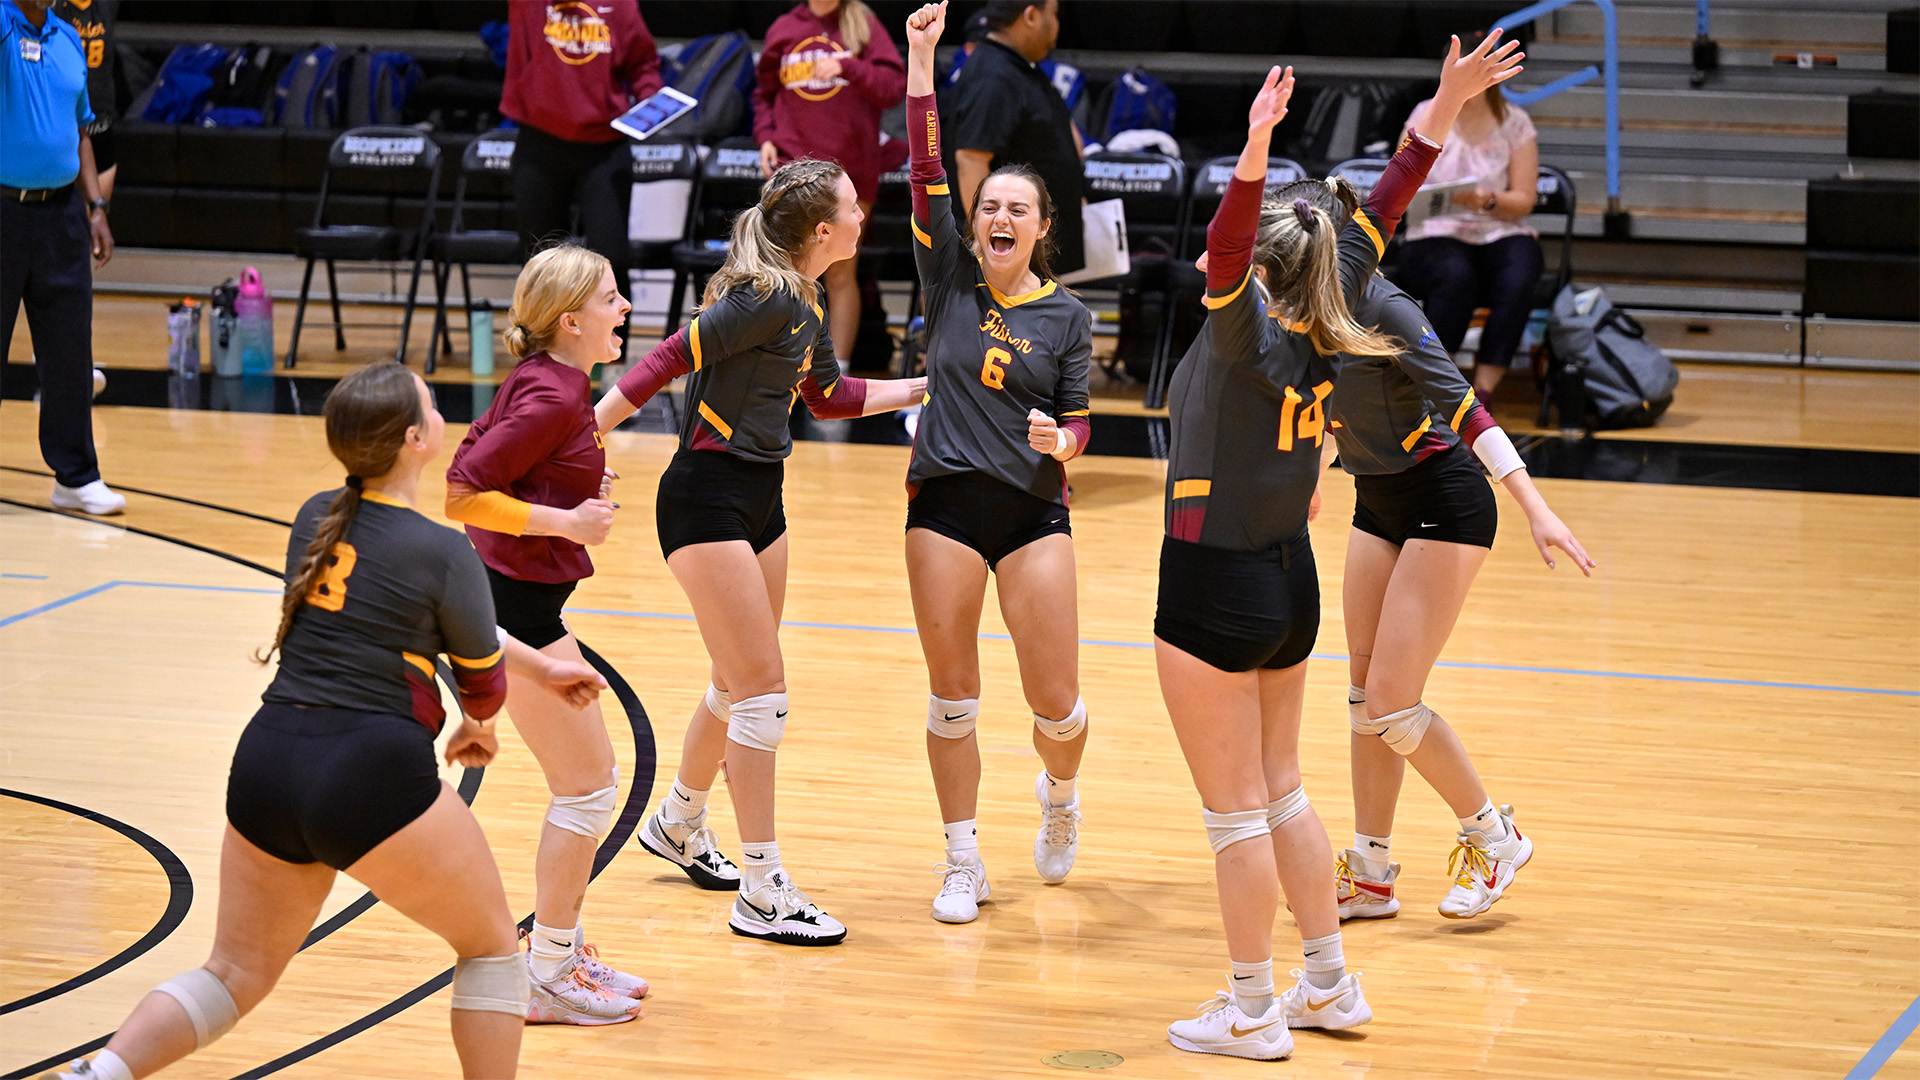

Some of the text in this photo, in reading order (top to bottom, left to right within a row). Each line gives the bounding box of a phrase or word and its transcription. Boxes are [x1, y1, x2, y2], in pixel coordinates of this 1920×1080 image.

[926, 110, 938, 157] CARDINALS
[343, 136, 424, 154] HOPKINS
[350, 153, 415, 166] ATHLETICS
[1084, 160, 1172, 181] HOPKINS
[1091, 179, 1163, 193] ATHLETICS
[980, 346, 1012, 390] 6
[1277, 379, 1334, 452] 14
